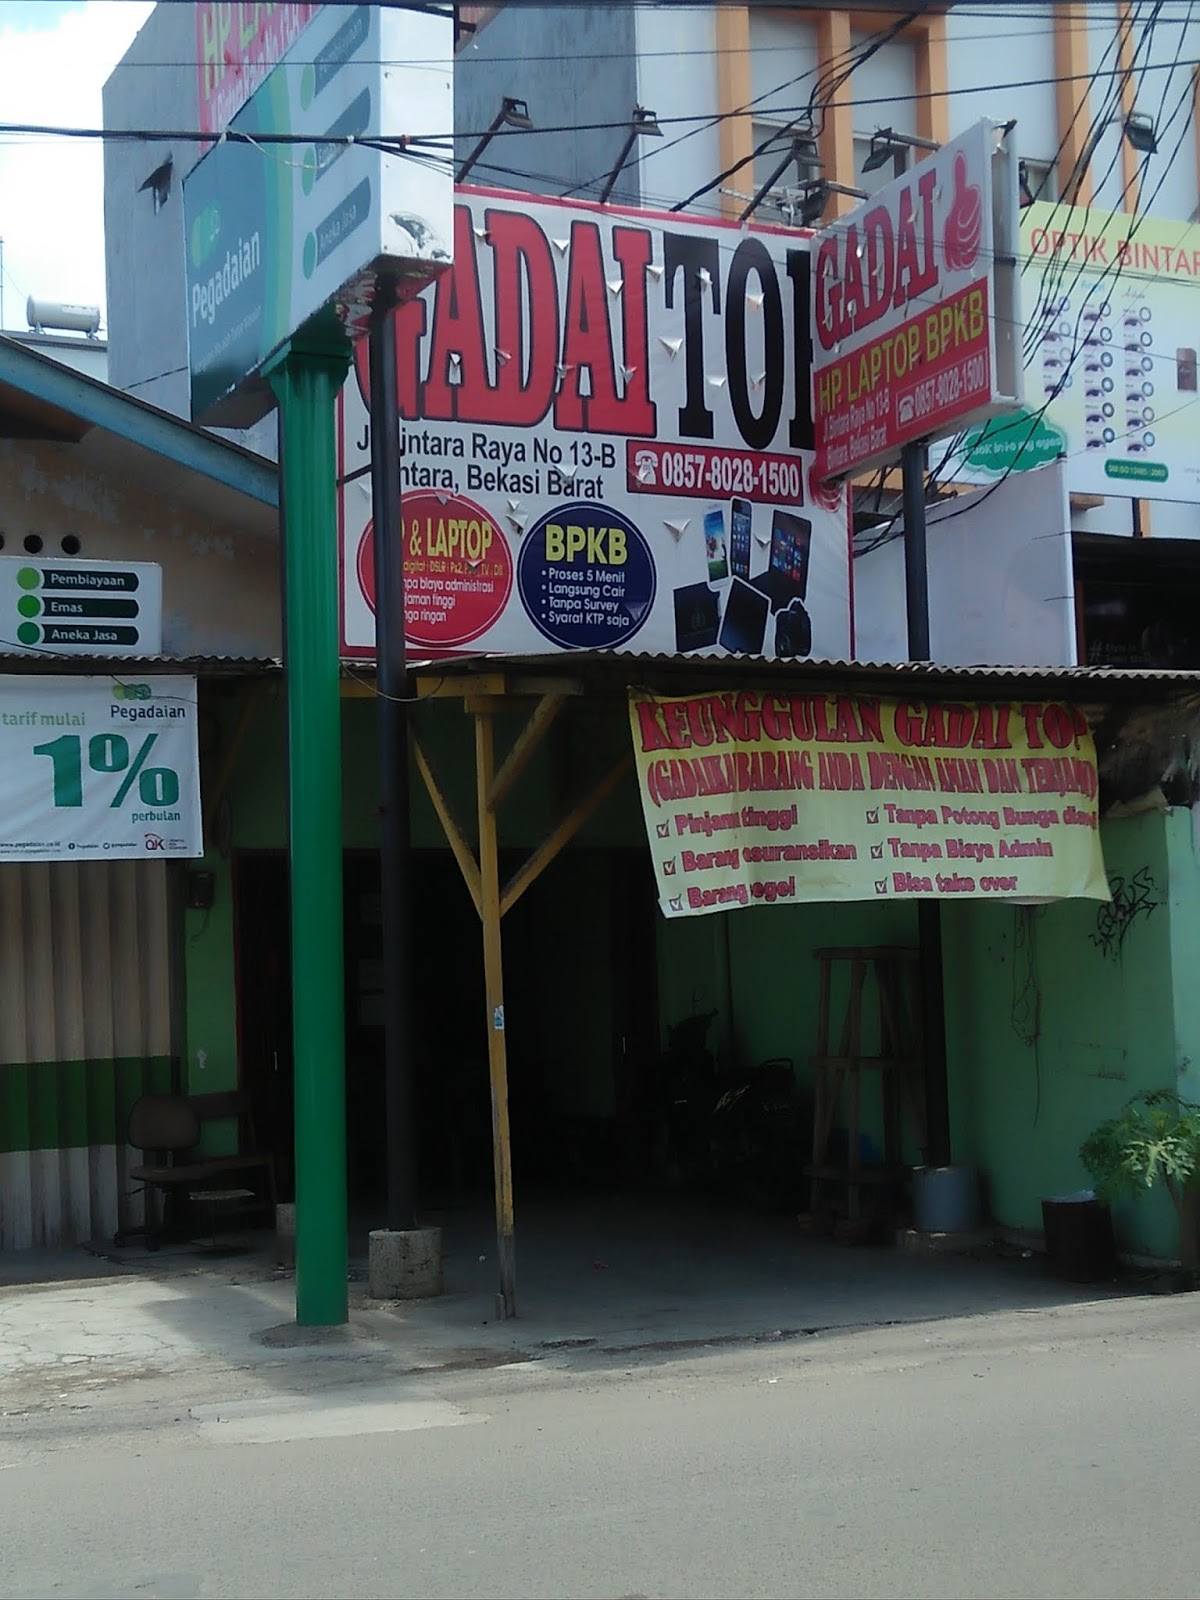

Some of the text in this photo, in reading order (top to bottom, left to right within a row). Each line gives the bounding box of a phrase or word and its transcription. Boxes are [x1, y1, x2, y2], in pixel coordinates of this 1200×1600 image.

[815, 168, 939, 351] GADAI
[1030, 228, 1108, 271] OPTIK
[192, 231, 261, 328] Pegadaian
[848, 325, 921, 402] LAPTOP
[926, 288, 985, 363] BPKB
[472, 432, 527, 467] Raya
[533, 437, 563, 463] No
[570, 440, 617, 469] 13-B
[467, 464, 541, 495] Bekasi
[549, 470, 605, 500] Barat
[661, 451, 801, 498] 0857-8028-1500
[427, 517, 493, 560] LAPTOP
[545, 523, 629, 566] BPKB
[50, 572, 126, 588] Pembiayaan
[420, 577, 444, 593] biaya
[445, 578, 495, 594] administrasi
[548, 567, 626, 584] Proses 5 Menit
[548, 581, 626, 599] Langsung Cair
[50, 602, 83, 613] Emas
[420, 609, 447, 625] ringan
[548, 596, 620, 614] Tanpa Survey
[548, 610, 630, 628] Syarat KTP saja
[51, 629, 118, 642] Aneka Jasa
[2, 711, 85, 727] tarif mulai
[110, 704, 186, 722] Pegadaian
[635, 691, 885, 752] KEUNGGULAN
[893, 700, 1013, 749] GADAI
[33, 732, 180, 808] 1%
[736, 751, 814, 792] BARANG
[818, 751, 866, 791] ANDA
[866, 752, 936, 792] DENGAN
[935, 757, 985, 793] AMAN
[982, 757, 1023, 793] DAN
[131, 810, 181, 823] perbulan
[884, 804, 938, 829] Tanpa
[940, 805, 1001, 830] Potong
[1003, 806, 1060, 829] Bunga
[681, 848, 740, 872] Barang
[887, 838, 1054, 863] Tanpa Biaya Admin
[687, 876, 796, 909] Barang egel
[892, 872, 1019, 893] Bisa take over
